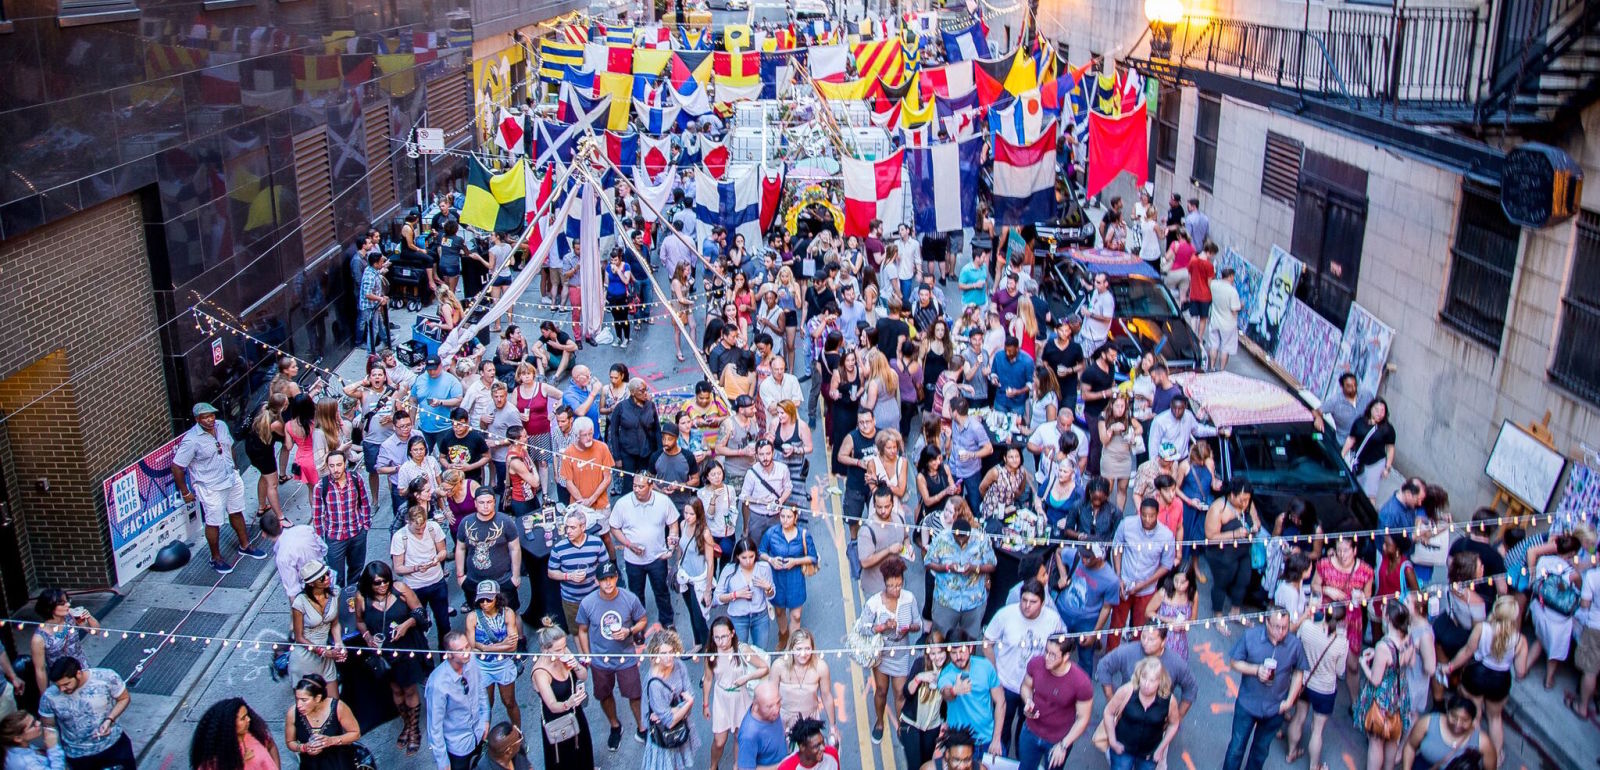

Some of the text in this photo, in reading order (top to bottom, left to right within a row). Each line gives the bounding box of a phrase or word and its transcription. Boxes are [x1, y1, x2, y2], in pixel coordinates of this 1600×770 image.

[116, 474, 134, 494] ACTI
[117, 487, 136, 505] VATE
[119, 499, 138, 518] 2016
